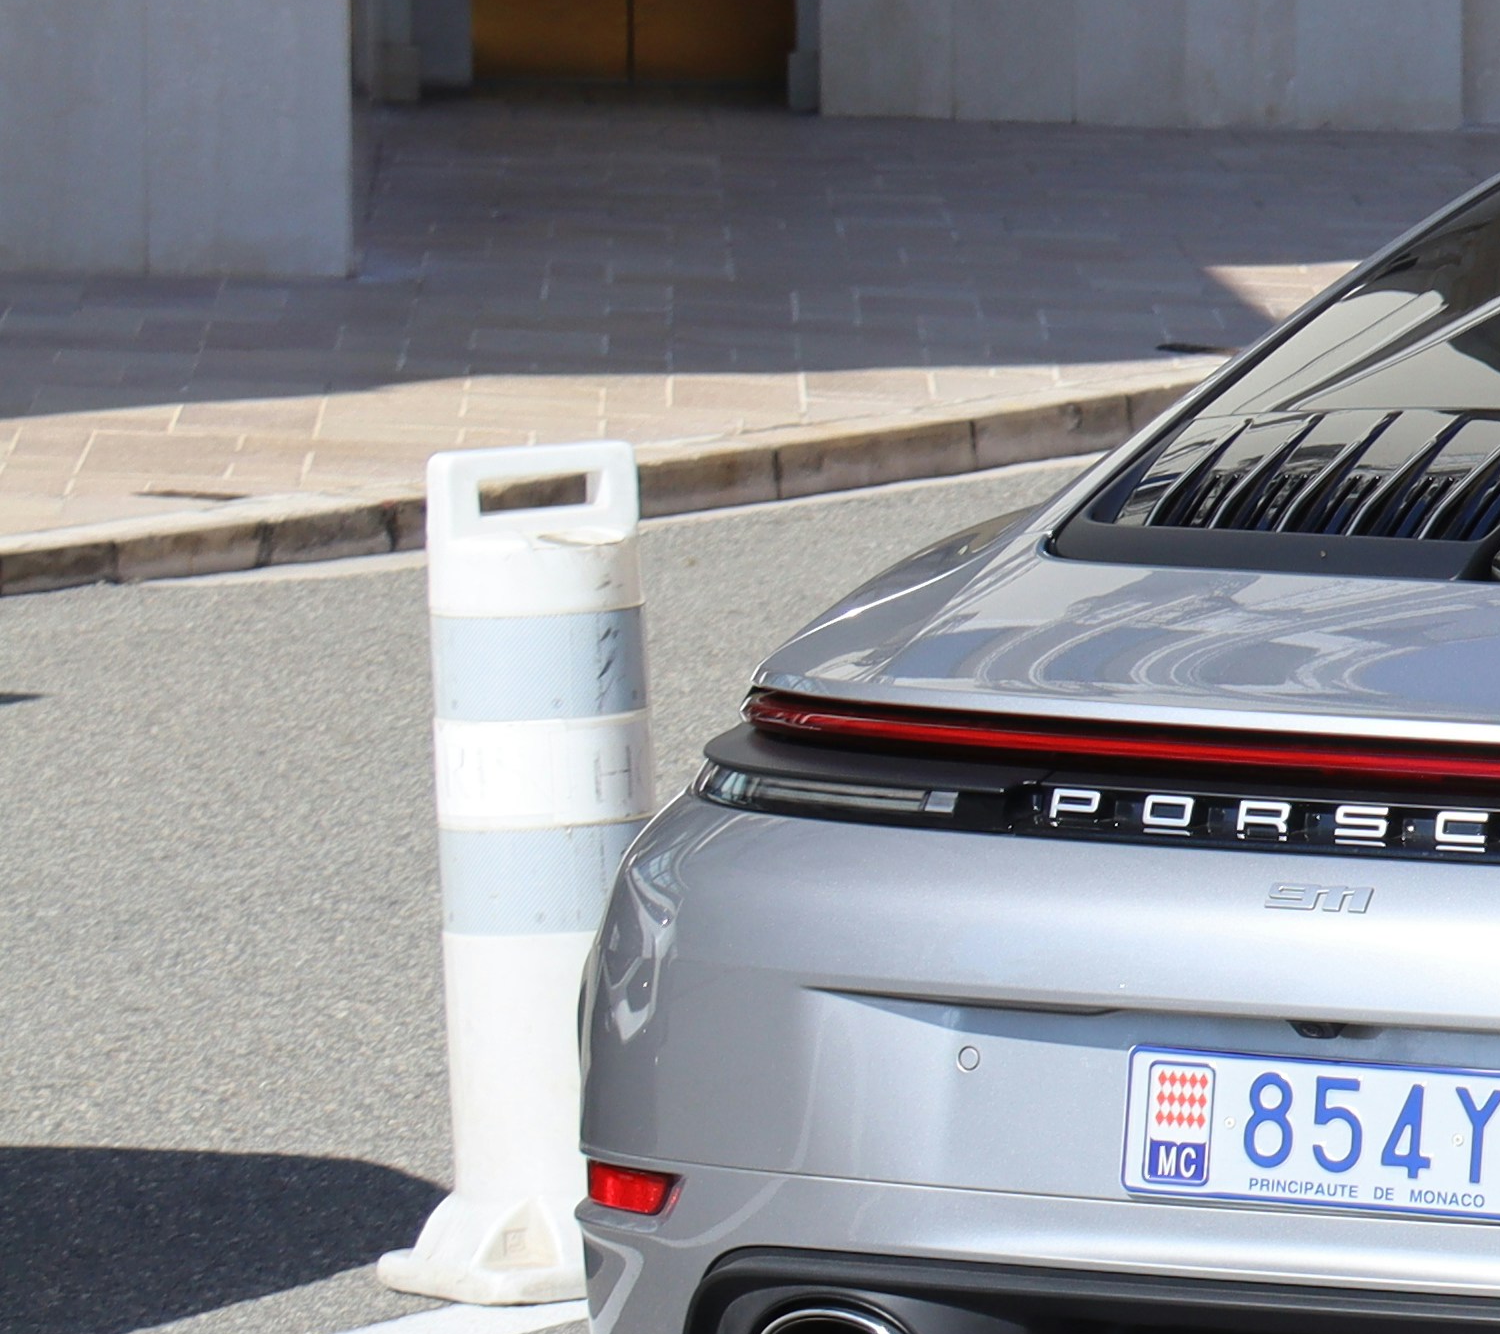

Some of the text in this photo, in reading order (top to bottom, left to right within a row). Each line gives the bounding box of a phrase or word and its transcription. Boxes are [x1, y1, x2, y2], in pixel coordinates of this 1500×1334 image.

[1264, 880, 1375, 914] 911
[1156, 1144, 1197, 1180] MC
[1248, 1177, 1486, 1209] PRINCIPAUTE DE MONACO
